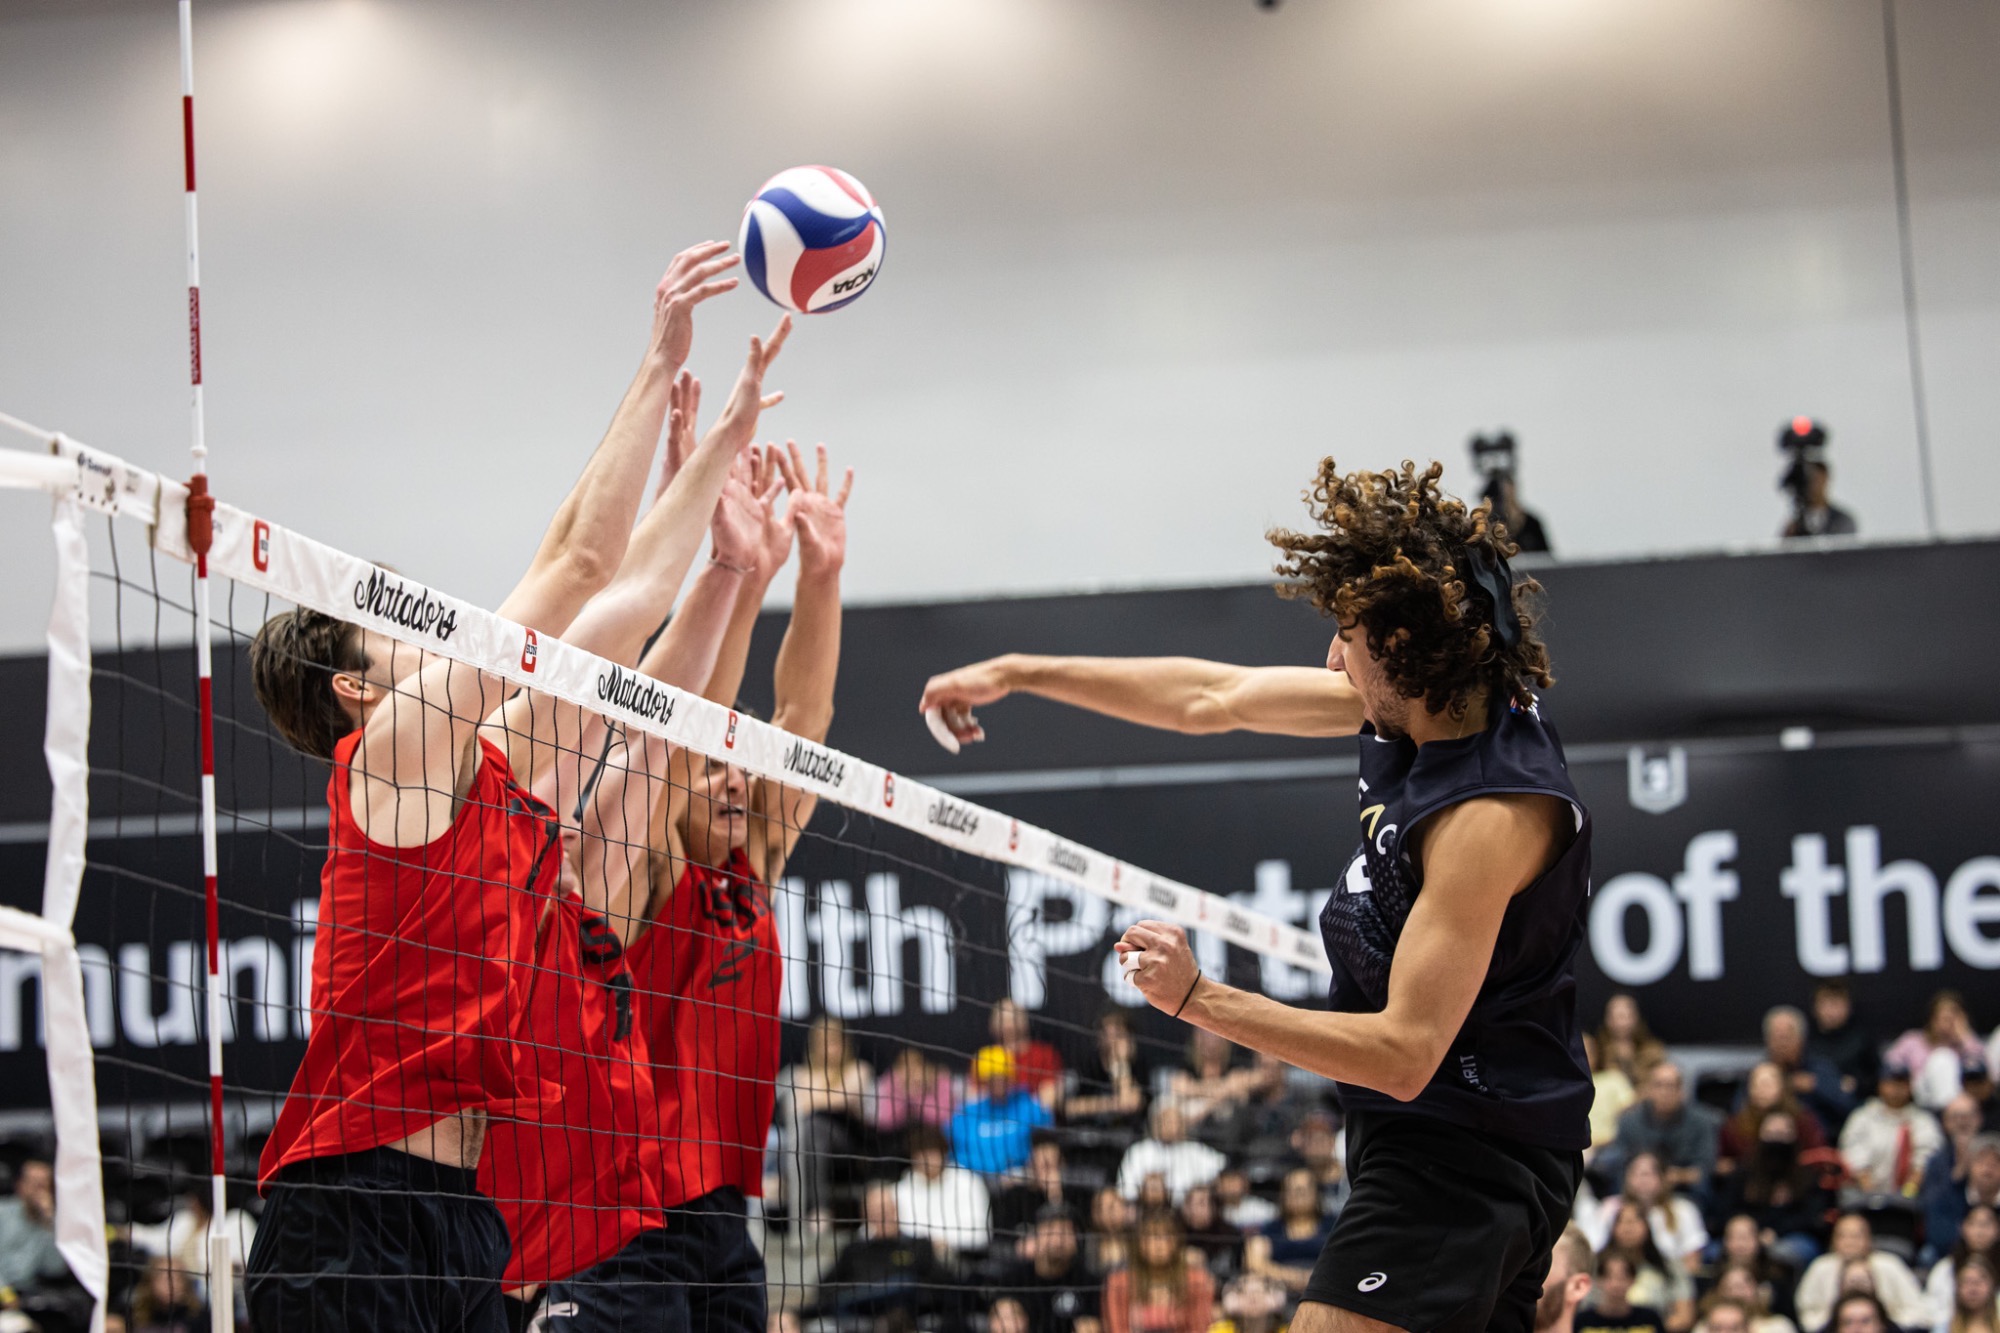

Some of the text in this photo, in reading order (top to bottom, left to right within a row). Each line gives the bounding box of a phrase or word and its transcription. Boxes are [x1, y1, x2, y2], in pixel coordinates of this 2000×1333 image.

[832, 262, 876, 295] NCAA
[354, 567, 458, 641] Matadors
[597, 663, 676, 725] Matadors
[1588, 829, 1741, 987] of
[1779, 823, 2000, 978] the
[707, 937, 760, 990] 2
